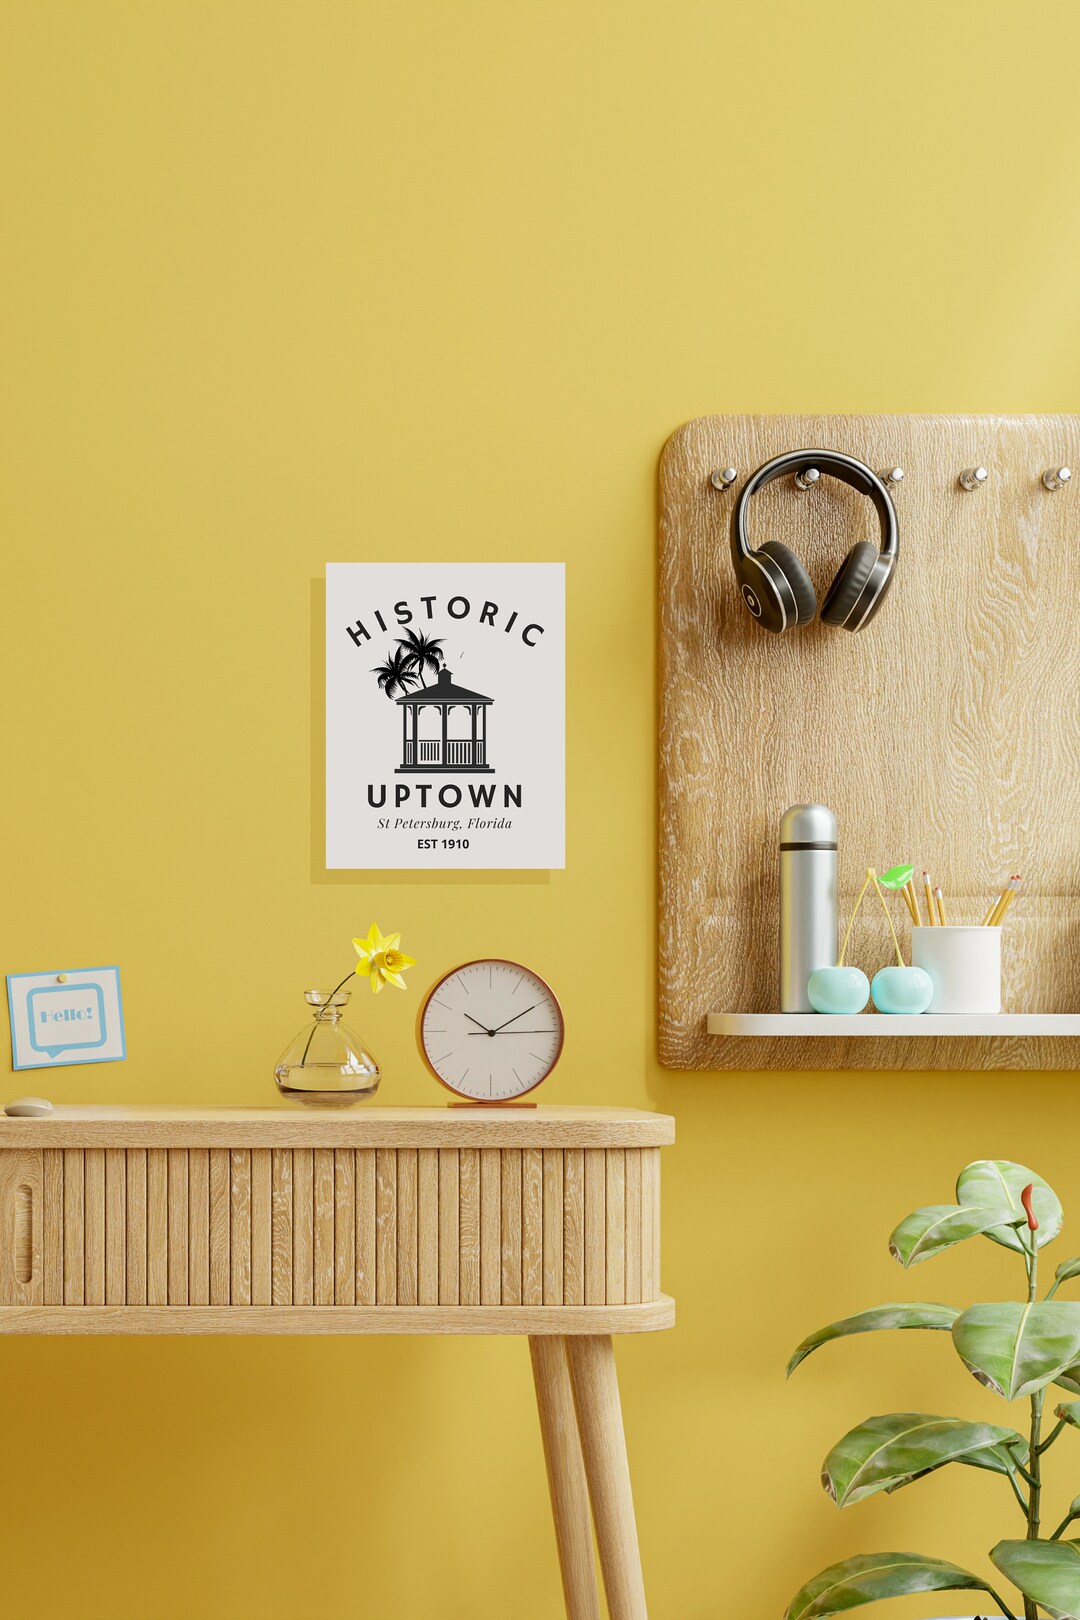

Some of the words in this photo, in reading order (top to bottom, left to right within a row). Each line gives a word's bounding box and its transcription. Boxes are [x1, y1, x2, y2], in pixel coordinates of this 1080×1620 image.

[345, 595, 545, 648] HISTORIC
[368, 784, 522, 808] UPTOWN
[376, 818, 390, 829] St
[394, 818, 463, 831] Petersburg,
[467, 818, 512, 829] Florida
[418, 839, 438, 849] EST
[442, 839, 469, 849] 1910
[41, 1007, 93, 1023] Hello!
